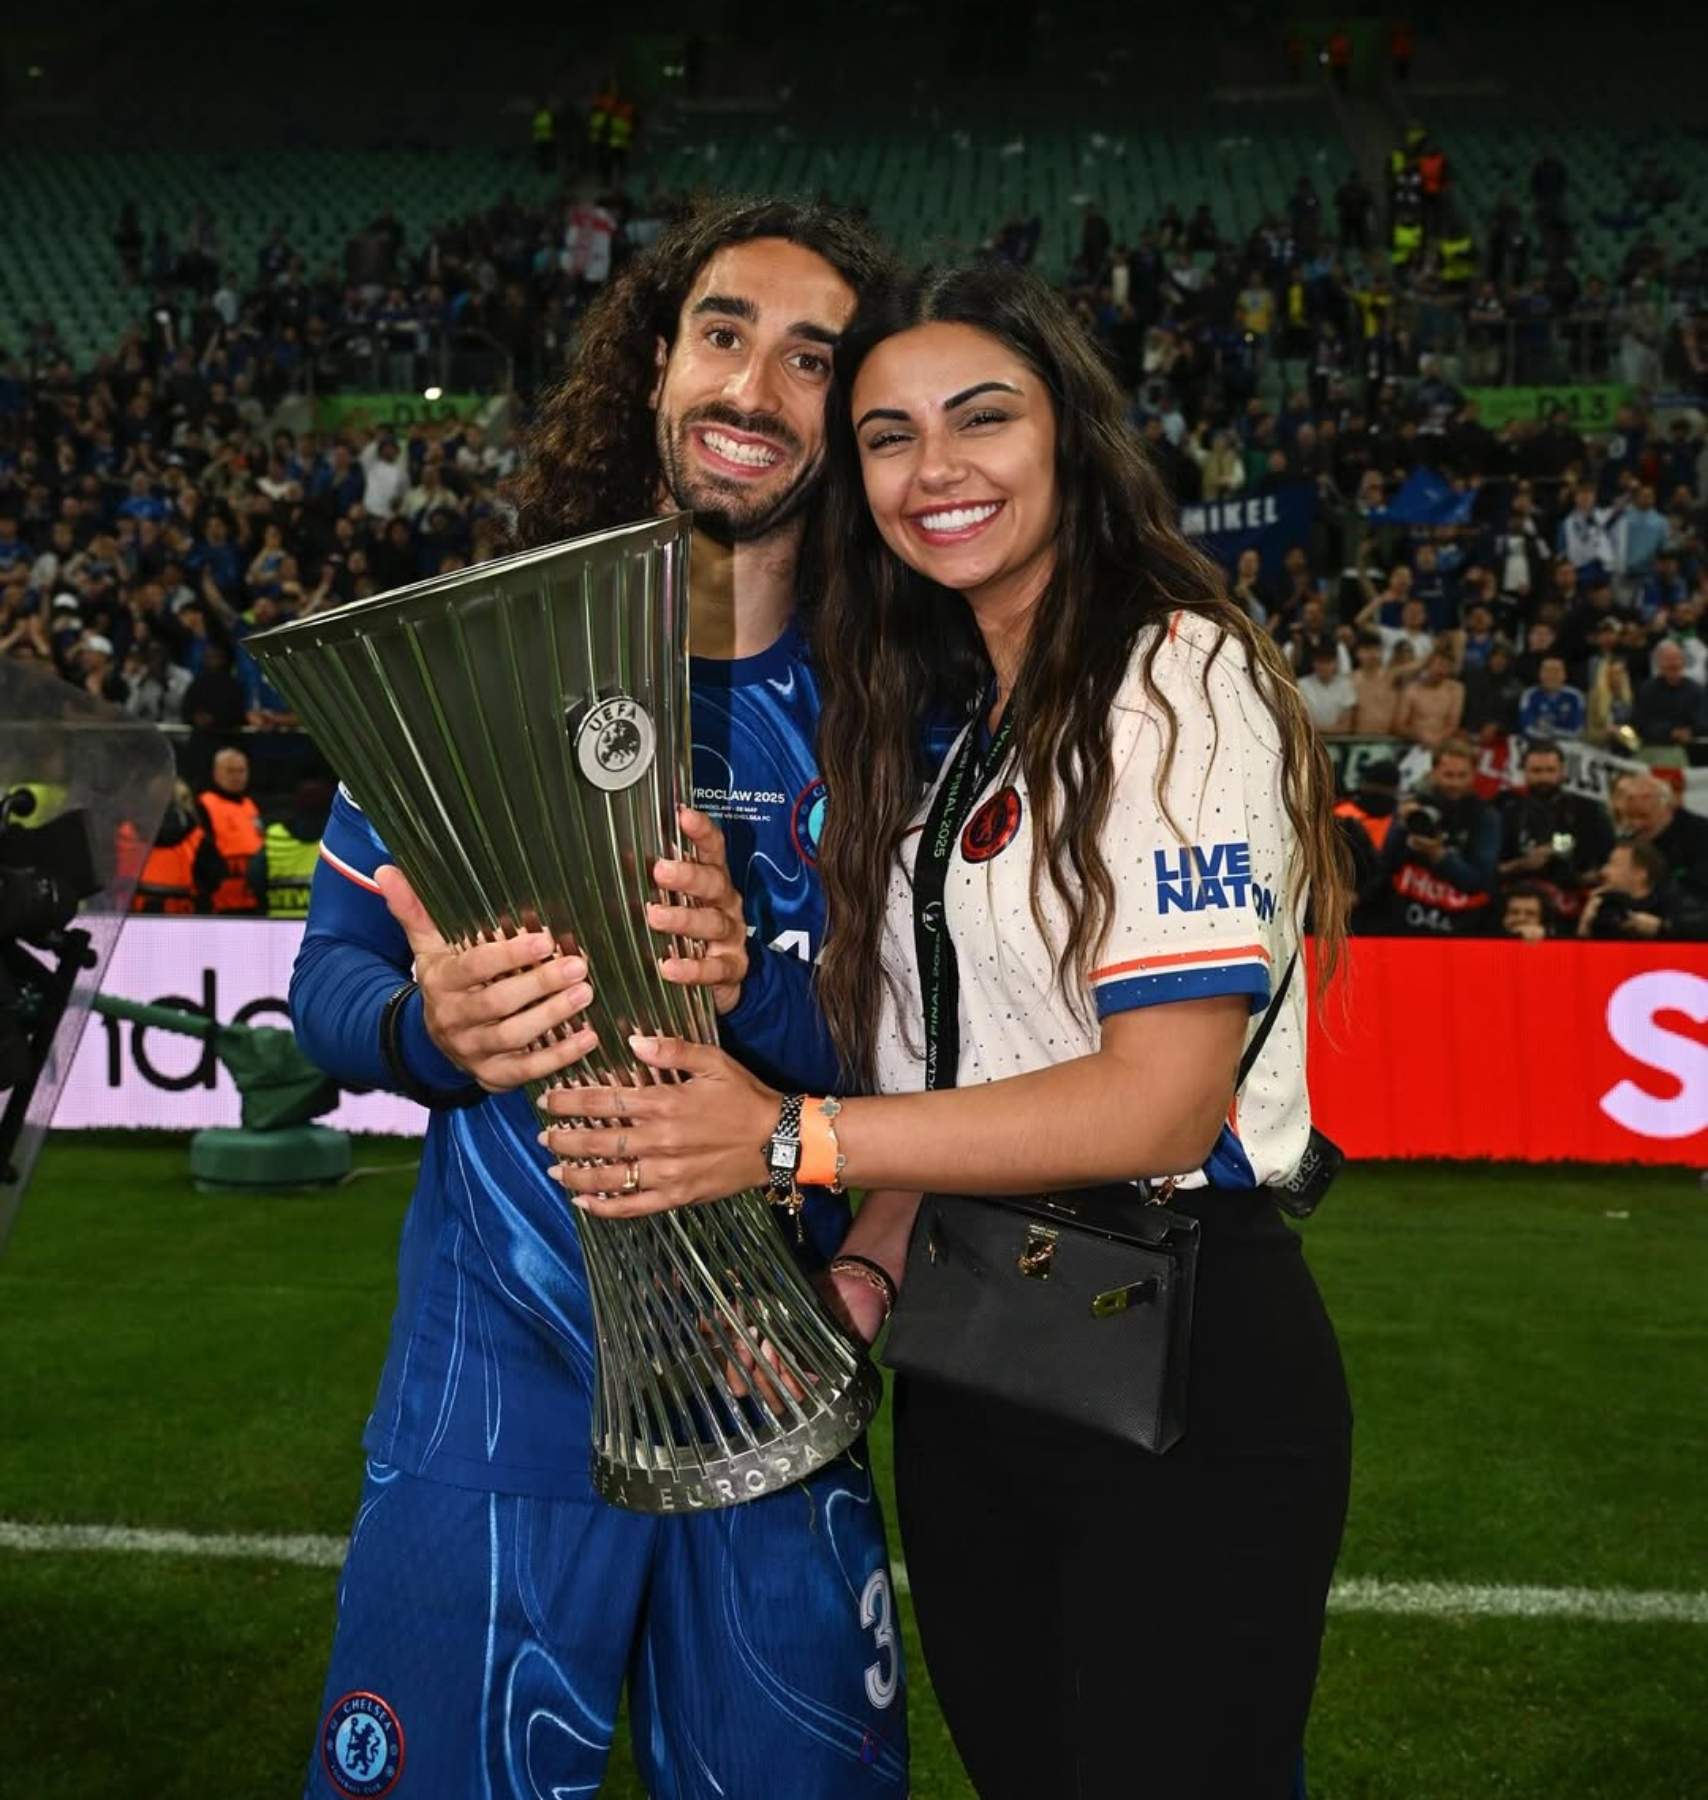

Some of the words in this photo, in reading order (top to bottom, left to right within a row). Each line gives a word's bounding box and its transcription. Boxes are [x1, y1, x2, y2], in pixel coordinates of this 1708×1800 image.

[1182, 496, 1278, 534] MIKEL
[588, 703, 637, 732] UEFA
[753, 791, 785, 804] 2025
[933, 819, 951, 858] 2025
[1154, 842, 1250, 882] LIVE
[1157, 875, 1277, 921] NATON
[659, 1445, 823, 1510] EUROPA
[860, 1568, 898, 1709] 3
[343, 1698, 392, 1731] CHELSEA
